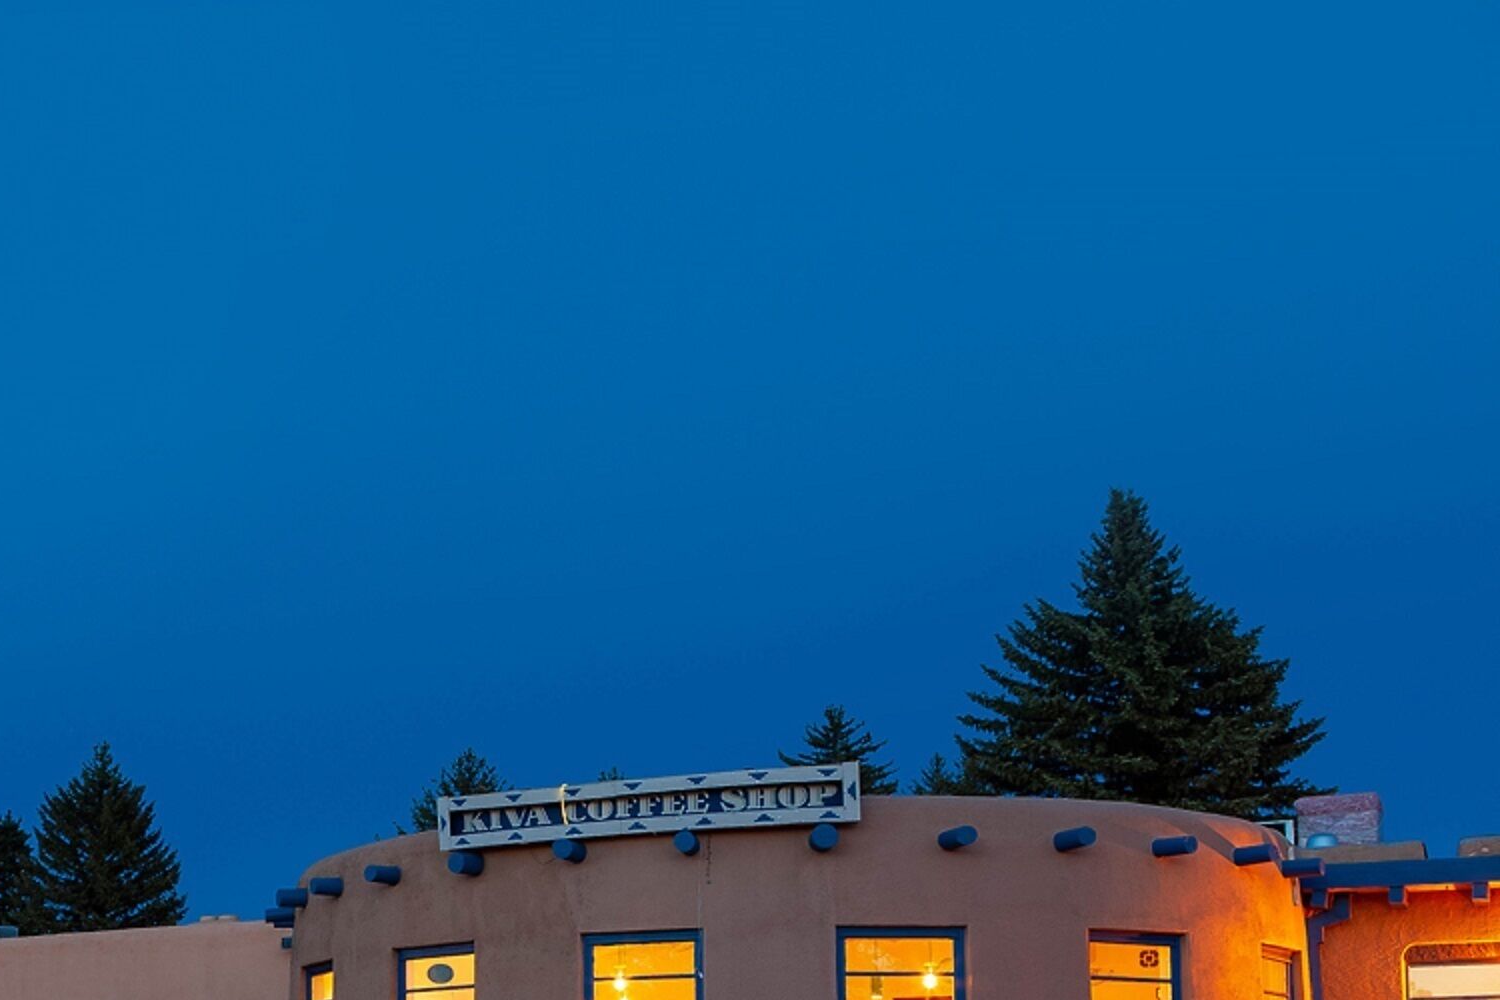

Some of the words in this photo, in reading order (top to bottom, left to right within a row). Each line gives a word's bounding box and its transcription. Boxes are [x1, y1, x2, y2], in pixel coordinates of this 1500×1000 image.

[462, 804, 551, 833] KIVA
[566, 790, 710, 823] COFFEE
[721, 783, 838, 812] SHOP
